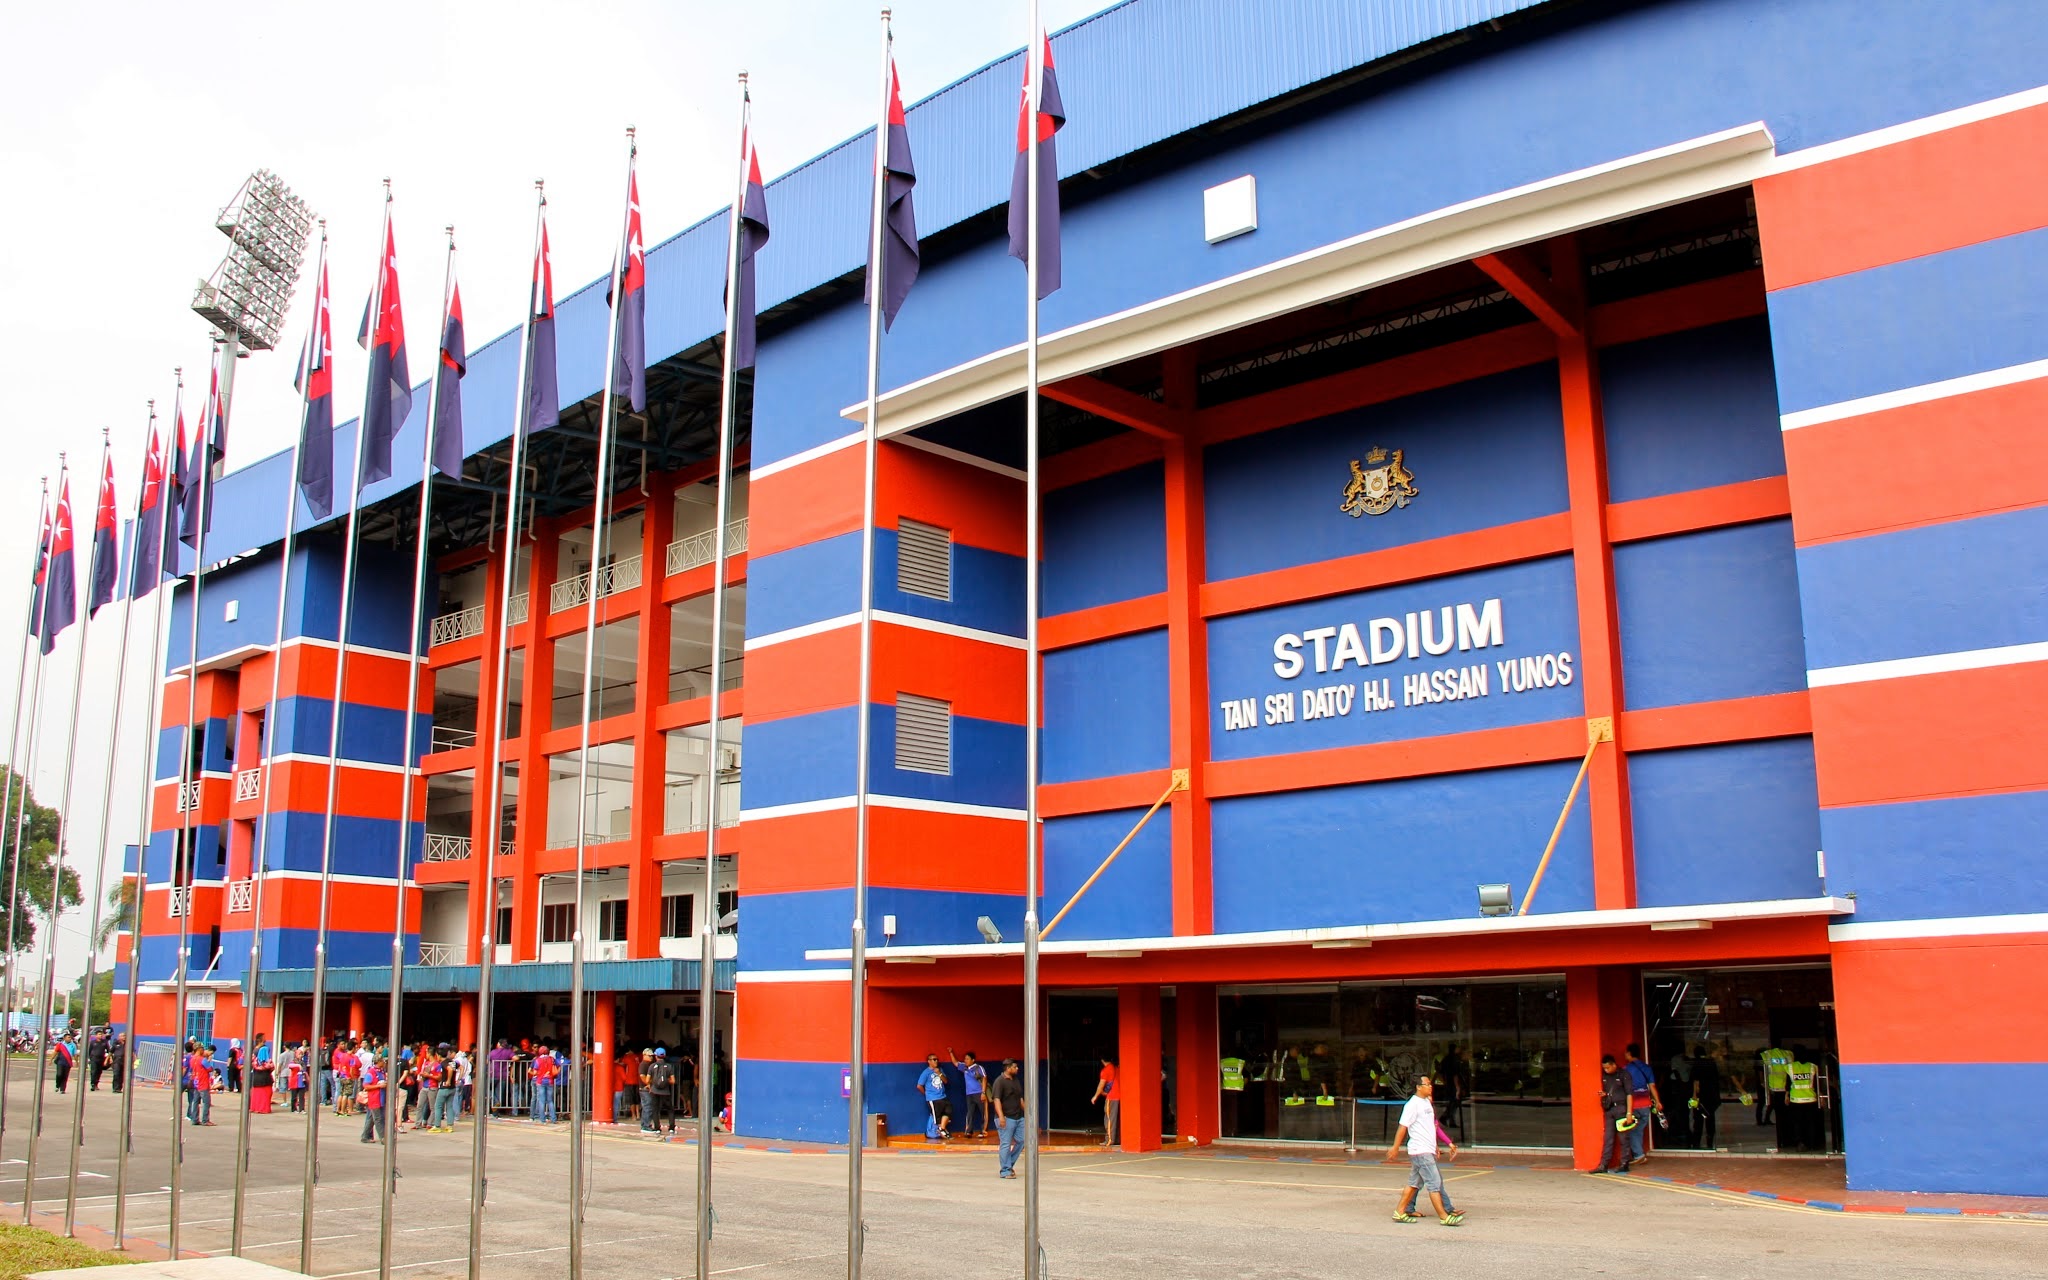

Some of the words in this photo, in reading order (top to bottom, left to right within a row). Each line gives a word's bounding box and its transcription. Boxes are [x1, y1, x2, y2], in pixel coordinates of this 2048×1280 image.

[1274, 599, 1503, 679] STADIUM
[1221, 698, 1257, 730] TAN
[1265, 692, 1294, 725] SRI
[1364, 681, 1396, 712] HJ.
[1404, 665, 1488, 706] HASSAN
[1496, 652, 1573, 693] YUNOS
